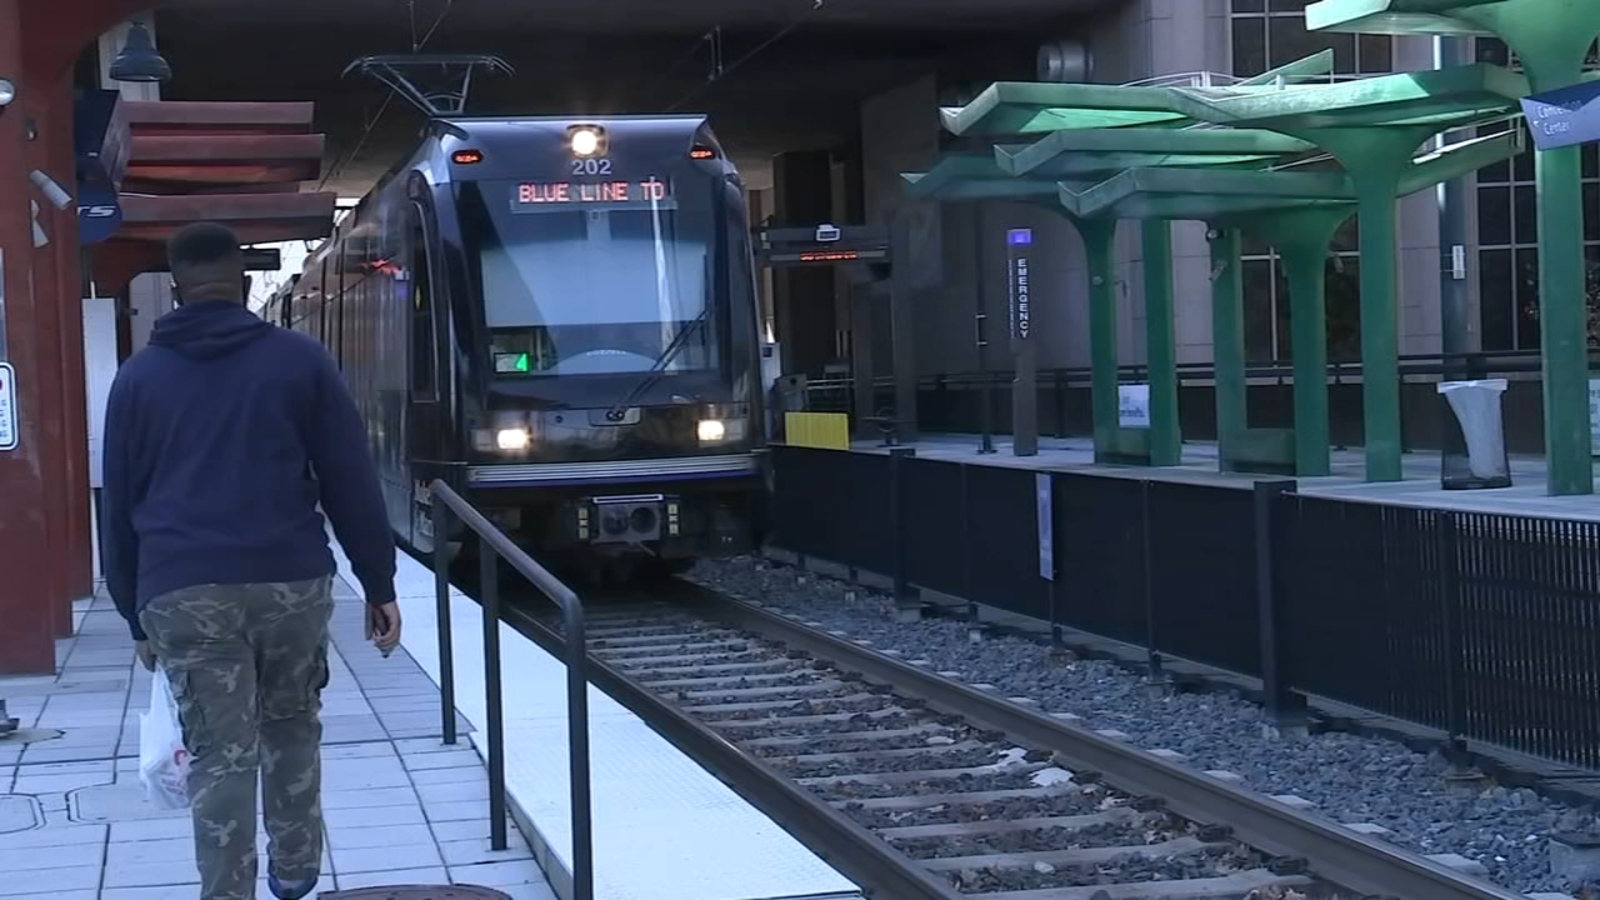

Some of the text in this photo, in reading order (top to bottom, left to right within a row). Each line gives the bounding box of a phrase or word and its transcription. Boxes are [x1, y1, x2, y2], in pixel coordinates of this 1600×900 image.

[571, 158, 612, 175] 202
[519, 182, 665, 203] BLUE LINE TO
[1017, 258, 1029, 339] EMERGENCY
